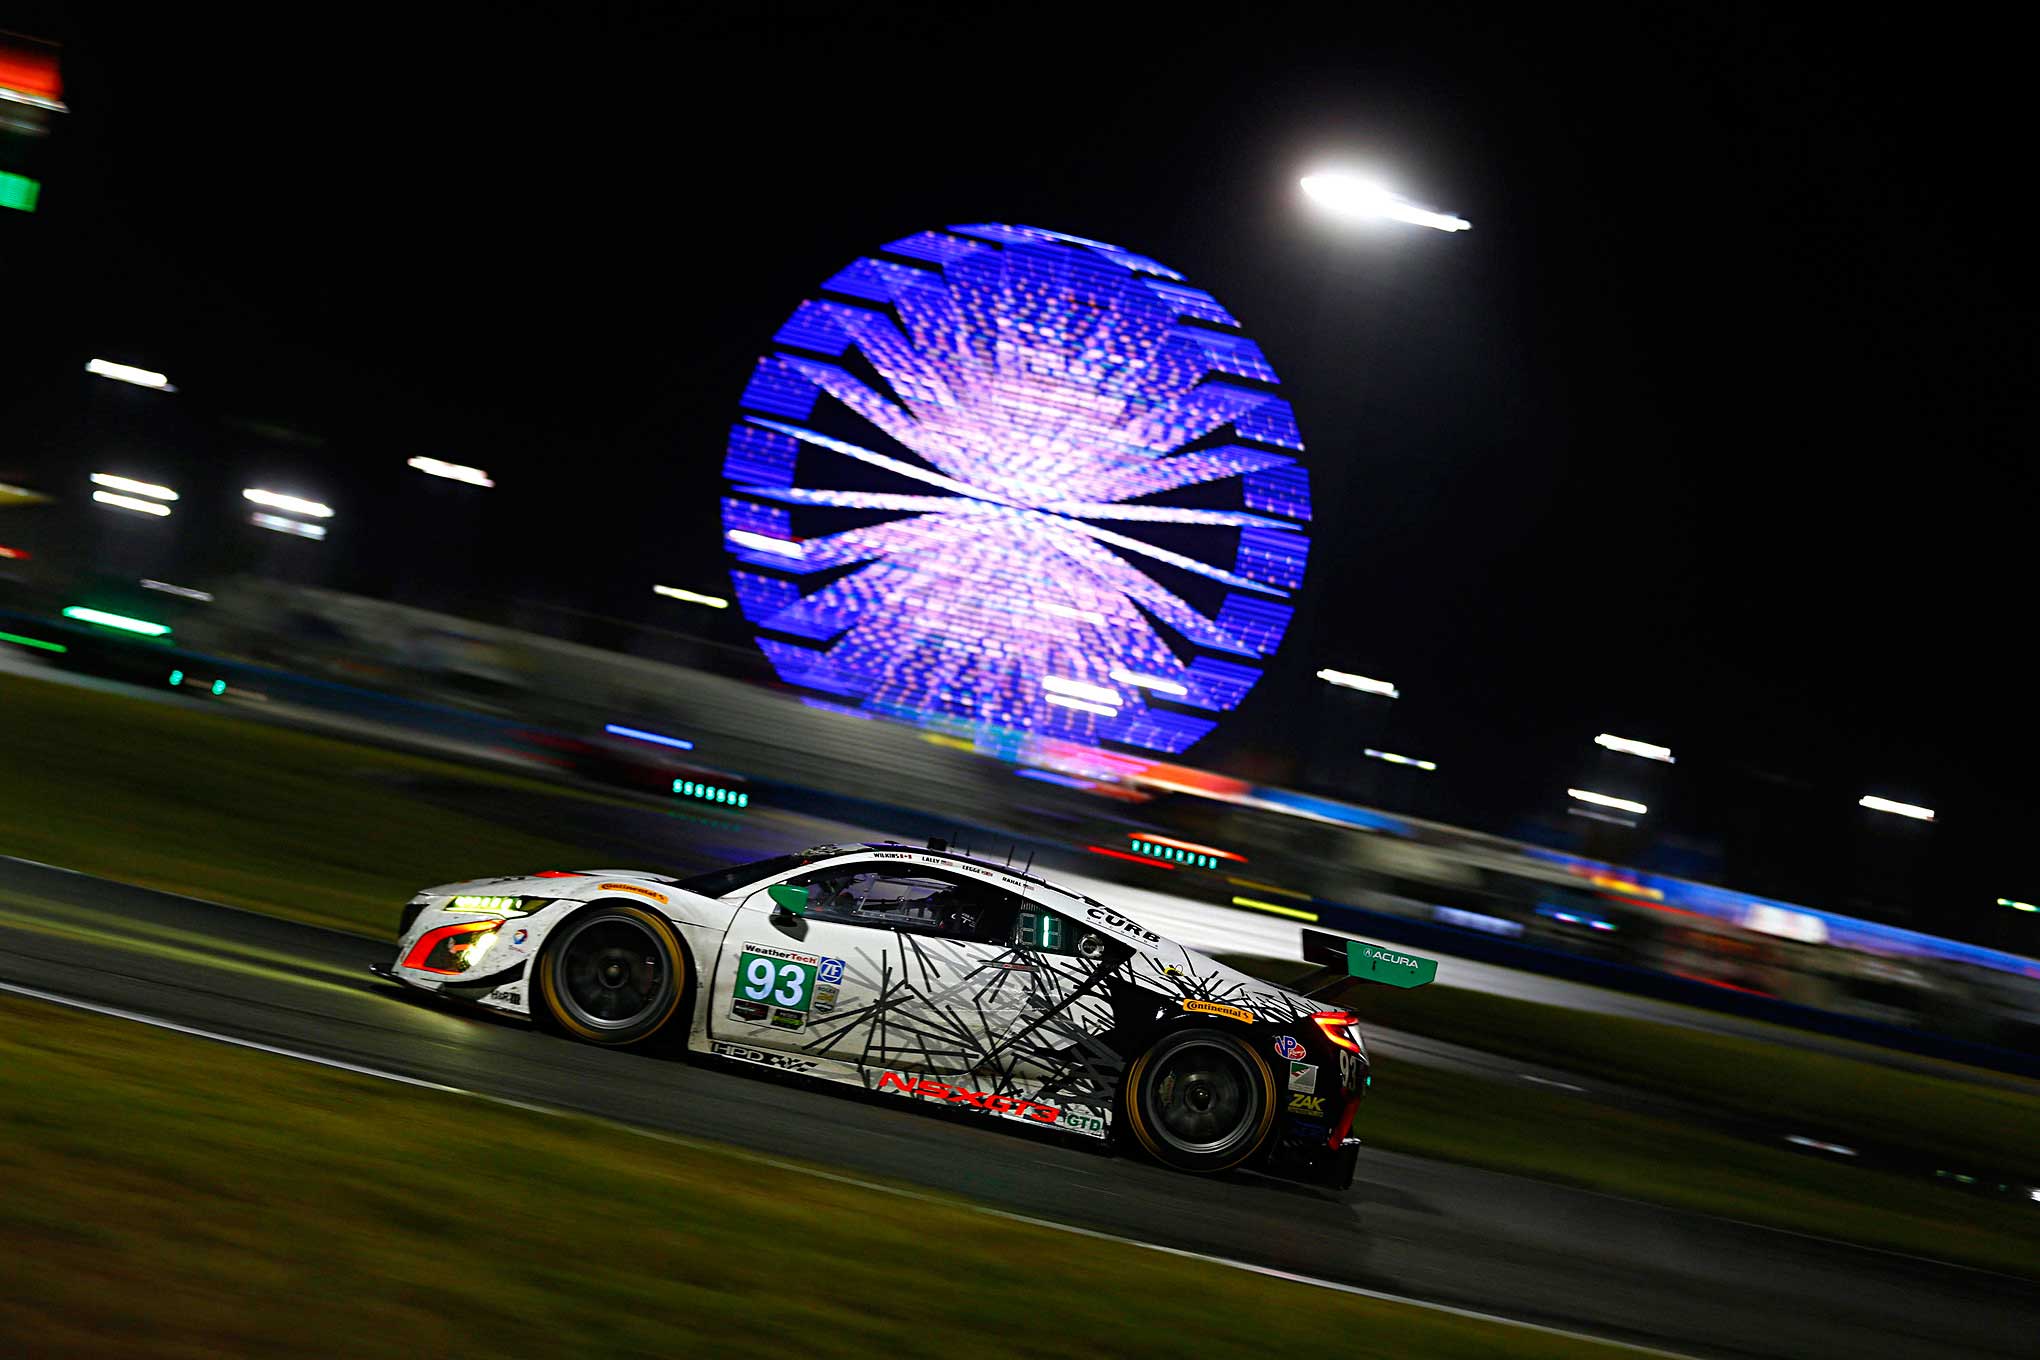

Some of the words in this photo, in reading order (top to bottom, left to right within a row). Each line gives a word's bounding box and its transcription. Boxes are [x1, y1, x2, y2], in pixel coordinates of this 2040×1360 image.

[922, 856, 940, 864] LALLY
[1086, 908, 1161, 943] CURB
[745, 944, 817, 964] WeatherTech
[1372, 951, 1419, 968] ACURA
[823, 962, 840, 977] ZF
[745, 957, 806, 1007] 93
[1186, 1000, 1241, 1017] Continental
[714, 1043, 765, 1061] HPD
[1289, 1093, 1327, 1111] ZAK
[1066, 1113, 1101, 1131] GTD
